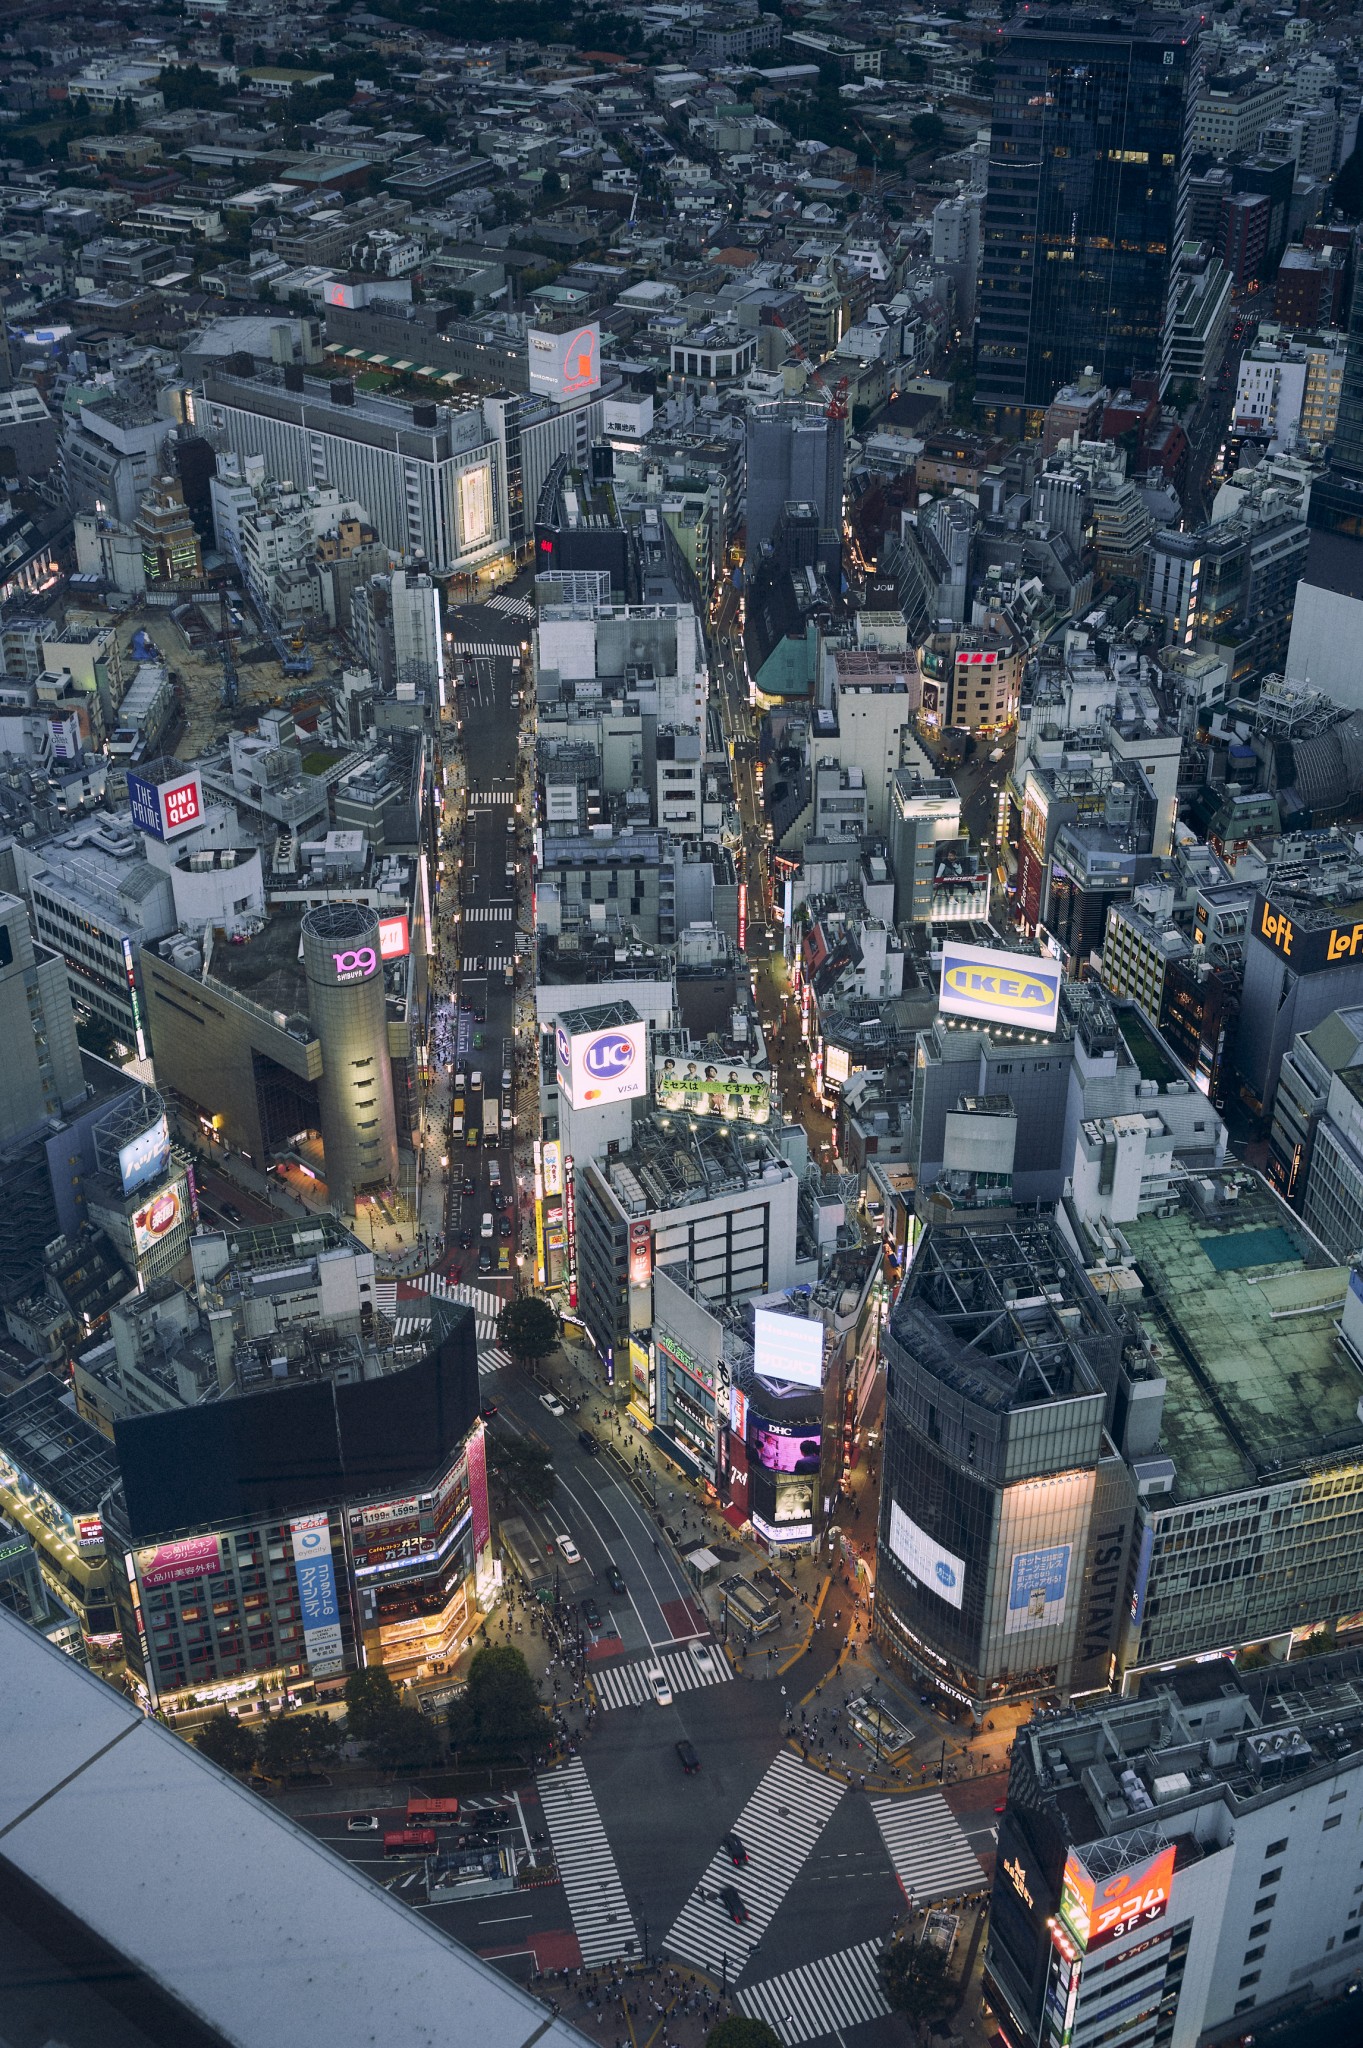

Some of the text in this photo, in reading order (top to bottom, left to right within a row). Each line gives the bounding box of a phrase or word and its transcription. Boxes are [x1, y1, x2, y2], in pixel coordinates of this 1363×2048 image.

[135, 783, 152, 809] THE
[168, 788, 193, 809] UNI
[132, 800, 161, 832] PRIME
[170, 802, 196, 824] QLO
[1020, 855, 1030, 907] Bershka
[332, 947, 377, 976] 109
[336, 970, 363, 982] SHIBUYA
[955, 970, 1046, 1002] IKEA
[617, 1083, 639, 1094] VISA
[663, 1080, 699, 1091] ミセスは
[768, 1424, 793, 1436] DHC
[350, 1515, 362, 1524] 9F
[172, 1539, 213, 1554] 品川スキン
[297, 1546, 328, 1557] eyecity
[402, 1536, 427, 1548] ガスト
[174, 1547, 210, 1560] クリニック
[355, 1556, 367, 1565] 7F
[385, 1547, 417, 1560] ガスト
[153, 1561, 217, 1583] 品川美容外科
[300, 1567, 321, 1618] アイシティ
[318, 1564, 335, 1615] コンタクトの
[1080, 1523, 1126, 1663] TSUTAYA
[933, 1676, 973, 1708] TSUTAYA
[1096, 1887, 1166, 1932] アコム
[1113, 1914, 1140, 1938] 3F
[1127, 1936, 1161, 1957] アイフル
